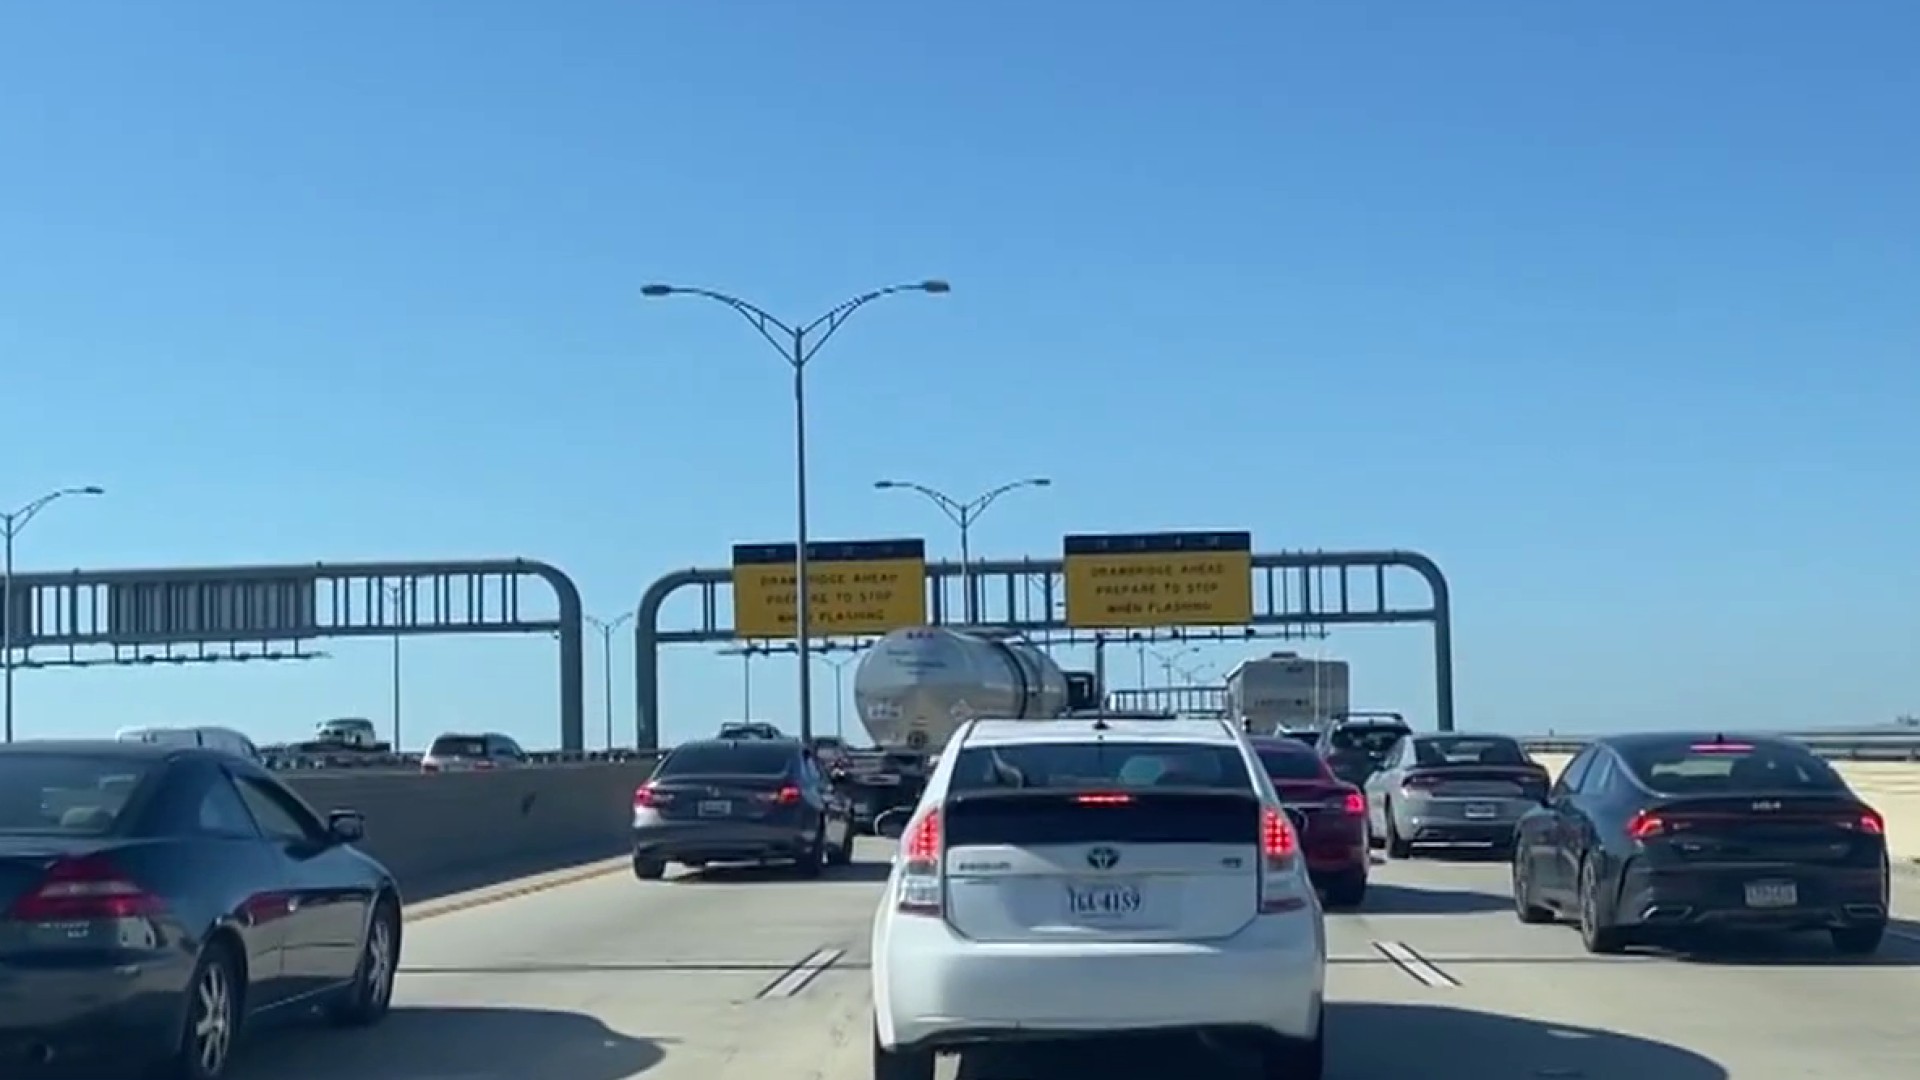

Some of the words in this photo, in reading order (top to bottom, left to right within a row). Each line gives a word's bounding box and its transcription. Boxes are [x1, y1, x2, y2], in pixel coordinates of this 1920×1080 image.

[1091, 565, 1172, 577] DRAWBRIDGE
[1180, 563, 1225, 574] AHEAD
[760, 574, 844, 586] DRAWRIDGE
[1096, 583, 1155, 595] PREPARE
[1164, 582, 1181, 594] TO
[1187, 582, 1218, 594] STOP
[766, 592, 828, 604] PREPRE
[836, 591, 852, 603] TO
[859, 590, 892, 602] STOP
[1107, 602, 1142, 613] WHEN
[777, 613, 813, 623] WHN
